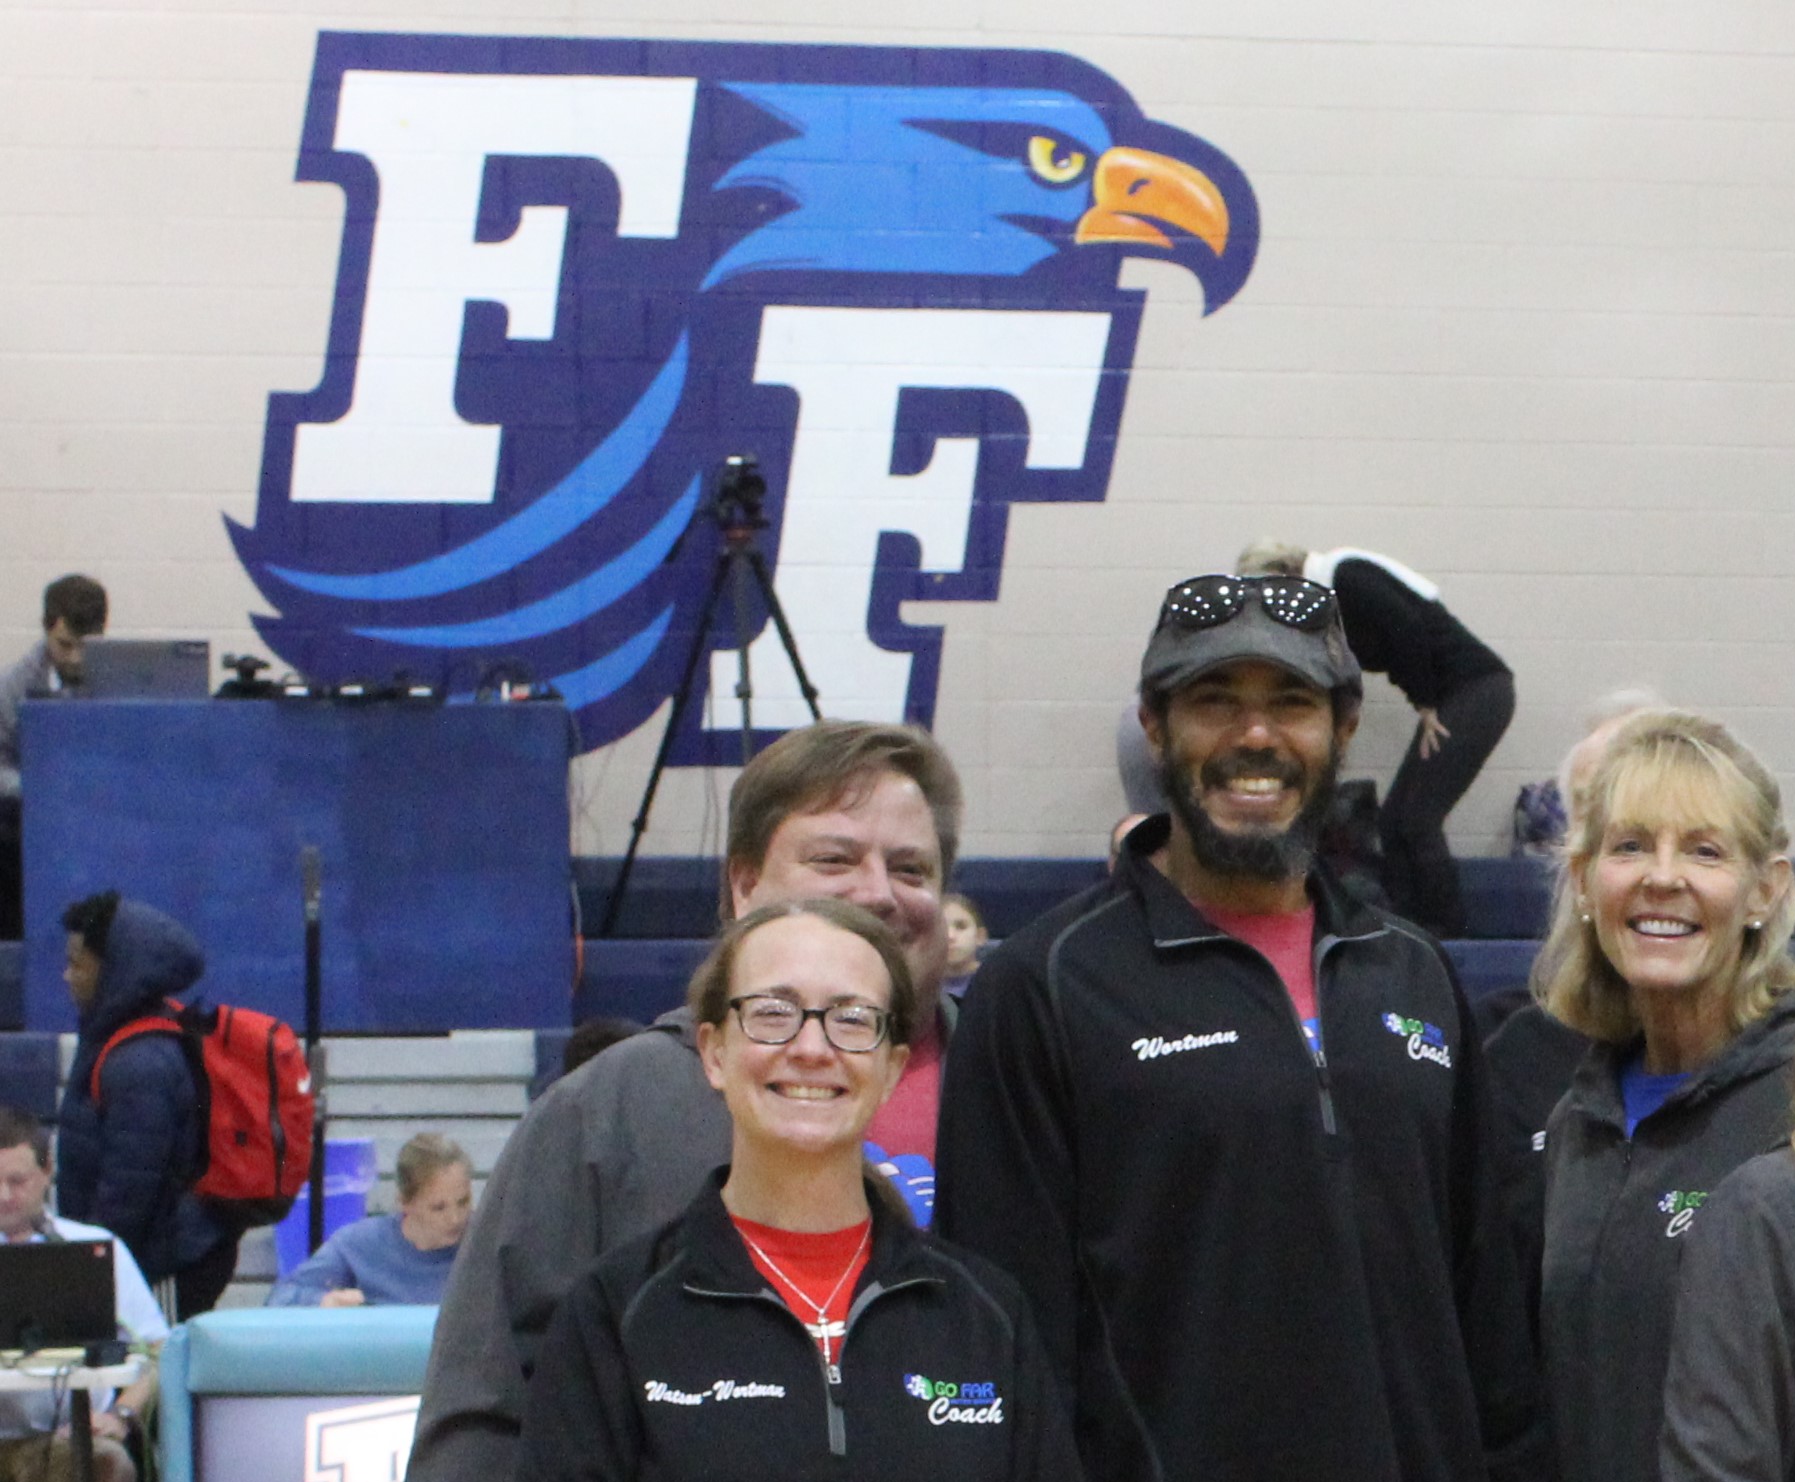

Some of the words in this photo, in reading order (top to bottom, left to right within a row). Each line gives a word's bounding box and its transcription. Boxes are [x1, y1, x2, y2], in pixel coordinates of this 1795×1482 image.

[1131, 1030, 1239, 1061] Wortman
[934, 1380, 958, 1398] GO
[961, 1382, 995, 1398] FAR
[927, 1396, 1004, 1425] Coach
